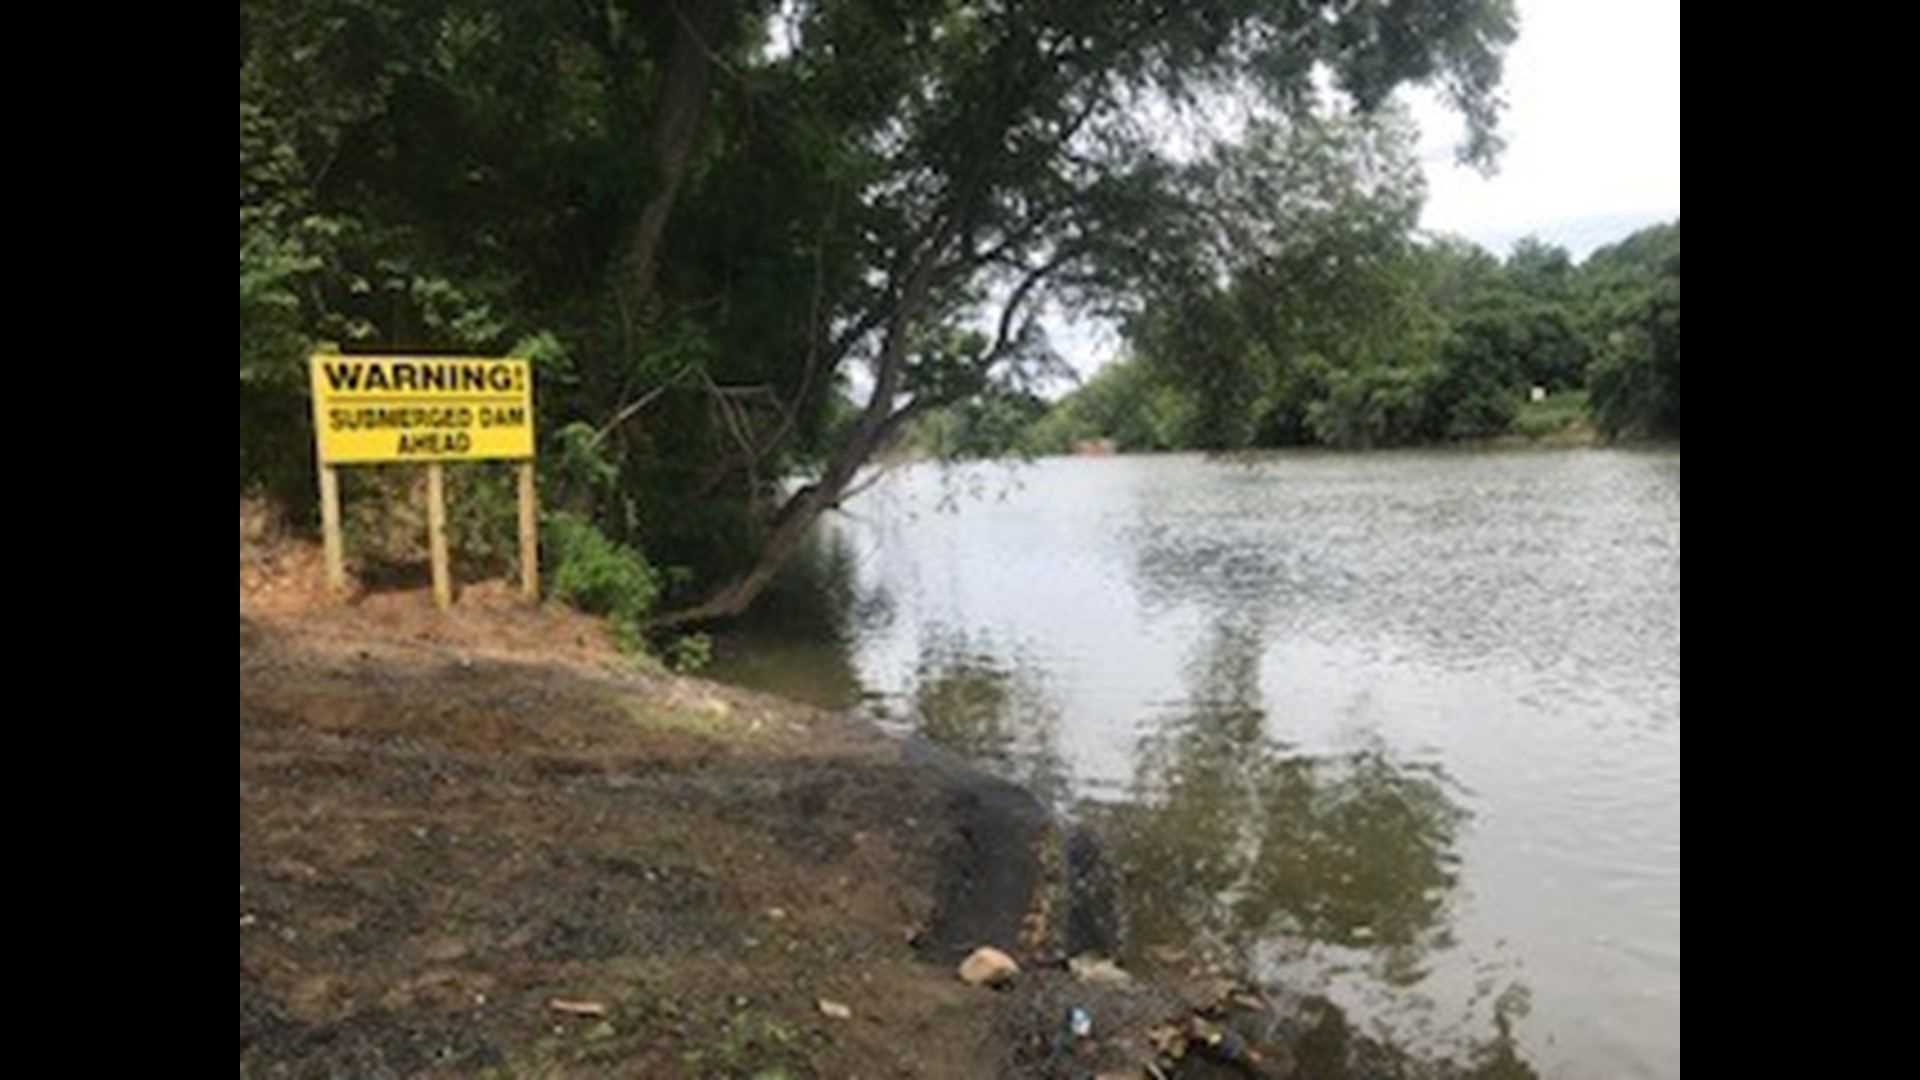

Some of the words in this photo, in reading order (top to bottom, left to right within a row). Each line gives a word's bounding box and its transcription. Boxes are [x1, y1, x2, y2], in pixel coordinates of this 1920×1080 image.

[323, 363, 524, 391] WARNING!
[329, 407, 473, 431] SUBMERGED
[479, 408, 524, 427] DAM
[397, 433, 471, 454] AHEAD
